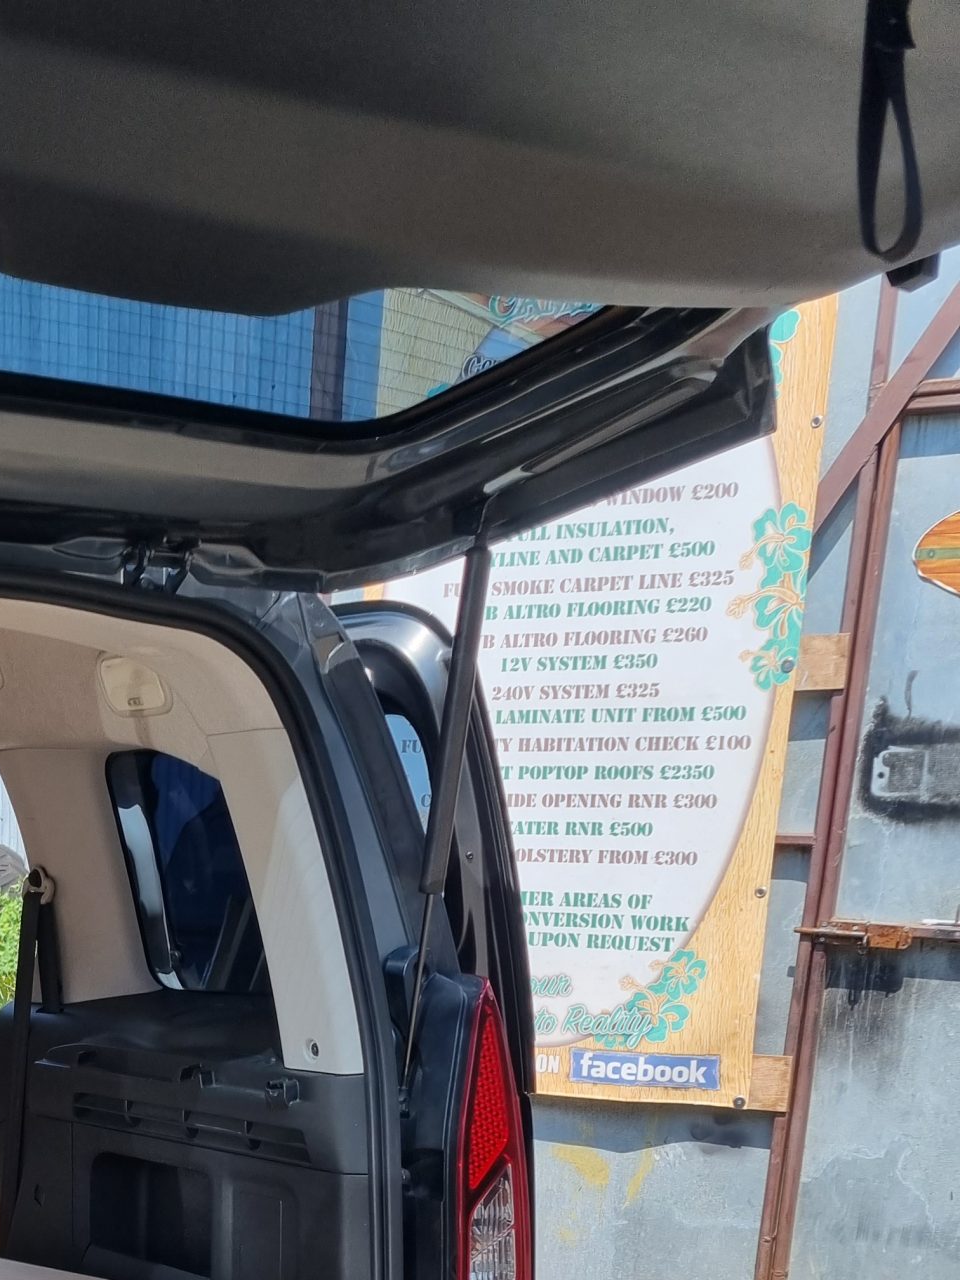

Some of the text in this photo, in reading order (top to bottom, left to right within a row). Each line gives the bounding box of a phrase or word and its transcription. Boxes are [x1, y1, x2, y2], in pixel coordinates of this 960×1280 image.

[691, 482, 739, 500] £200
[556, 517, 675, 540] INSULATION,
[545, 548, 583, 565] AND
[589, 544, 663, 562] CARPET
[669, 540, 716, 558] £500
[492, 579, 555, 596] SMOKE
[560, 575, 634, 594] CARPET
[640, 572, 683, 590] LINE
[688, 570, 735, 588] £325
[503, 603, 561, 620] ALTRO
[566, 598, 660, 618] FLOORING
[665, 596, 712, 613] £220
[500, 632, 558, 649] ALTRO
[563, 629, 656, 647] FLOORING
[661, 626, 708, 643] £260
[501, 653, 658, 672] 12V SYSTEM £350
[492, 682, 660, 702] 240V SYSTEM £325
[496, 705, 747, 725] LAMINATE UNIT FROM £500
[518, 737, 630, 752] HABITATION
[634, 735, 699, 751] CHECK
[705, 735, 751, 750] £100
[518, 765, 588, 780] POPTOP
[594, 765, 654, 780] ROOFS
[659, 764, 715, 780] £2350
[542, 793, 621, 809] OPENING
[627, 793, 667, 809] RNR
[672, 794, 717, 809] £300
[565, 821, 603, 836] RNR
[609, 822, 653, 837] £500
[598, 850, 648, 865] FROM
[653, 850, 698, 866] £300
[559, 892, 622, 909] AREAS
[627, 894, 653, 910] OF
[631, 915, 689, 932] WORK
[528, 932, 675, 952] UPON REQUEST
[562, 1003, 653, 1050] Reality
[536, 1052, 708, 1084] ON facebook
